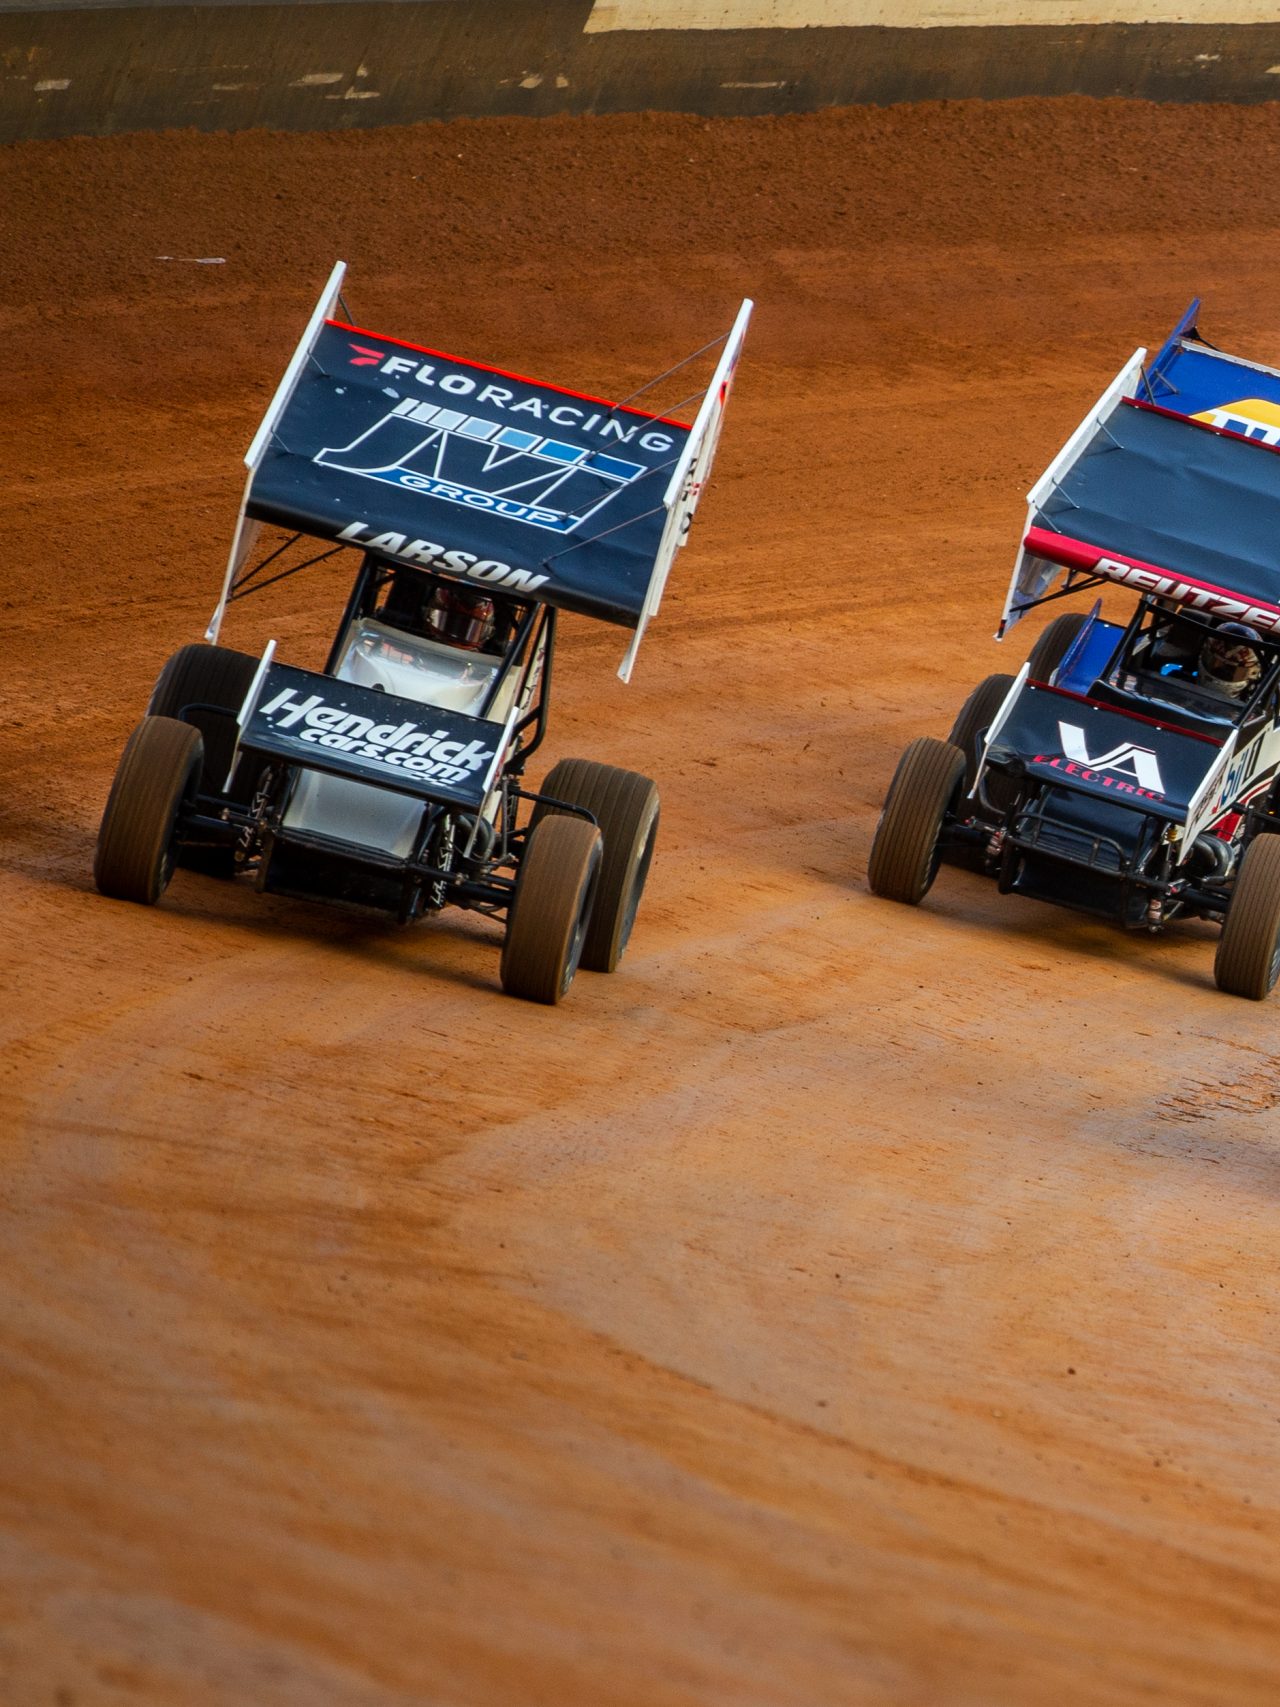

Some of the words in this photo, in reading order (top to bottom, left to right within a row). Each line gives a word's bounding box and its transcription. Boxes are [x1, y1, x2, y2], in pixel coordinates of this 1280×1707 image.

[380, 355, 674, 454] FLORACING
[399, 474, 561, 525] GROUP
[336, 520, 551, 593] LARSON
[259, 688, 495, 772] Hendrick
[300, 725, 473, 784] cars.com
[1032, 754, 1166, 801] ELECTRIC
